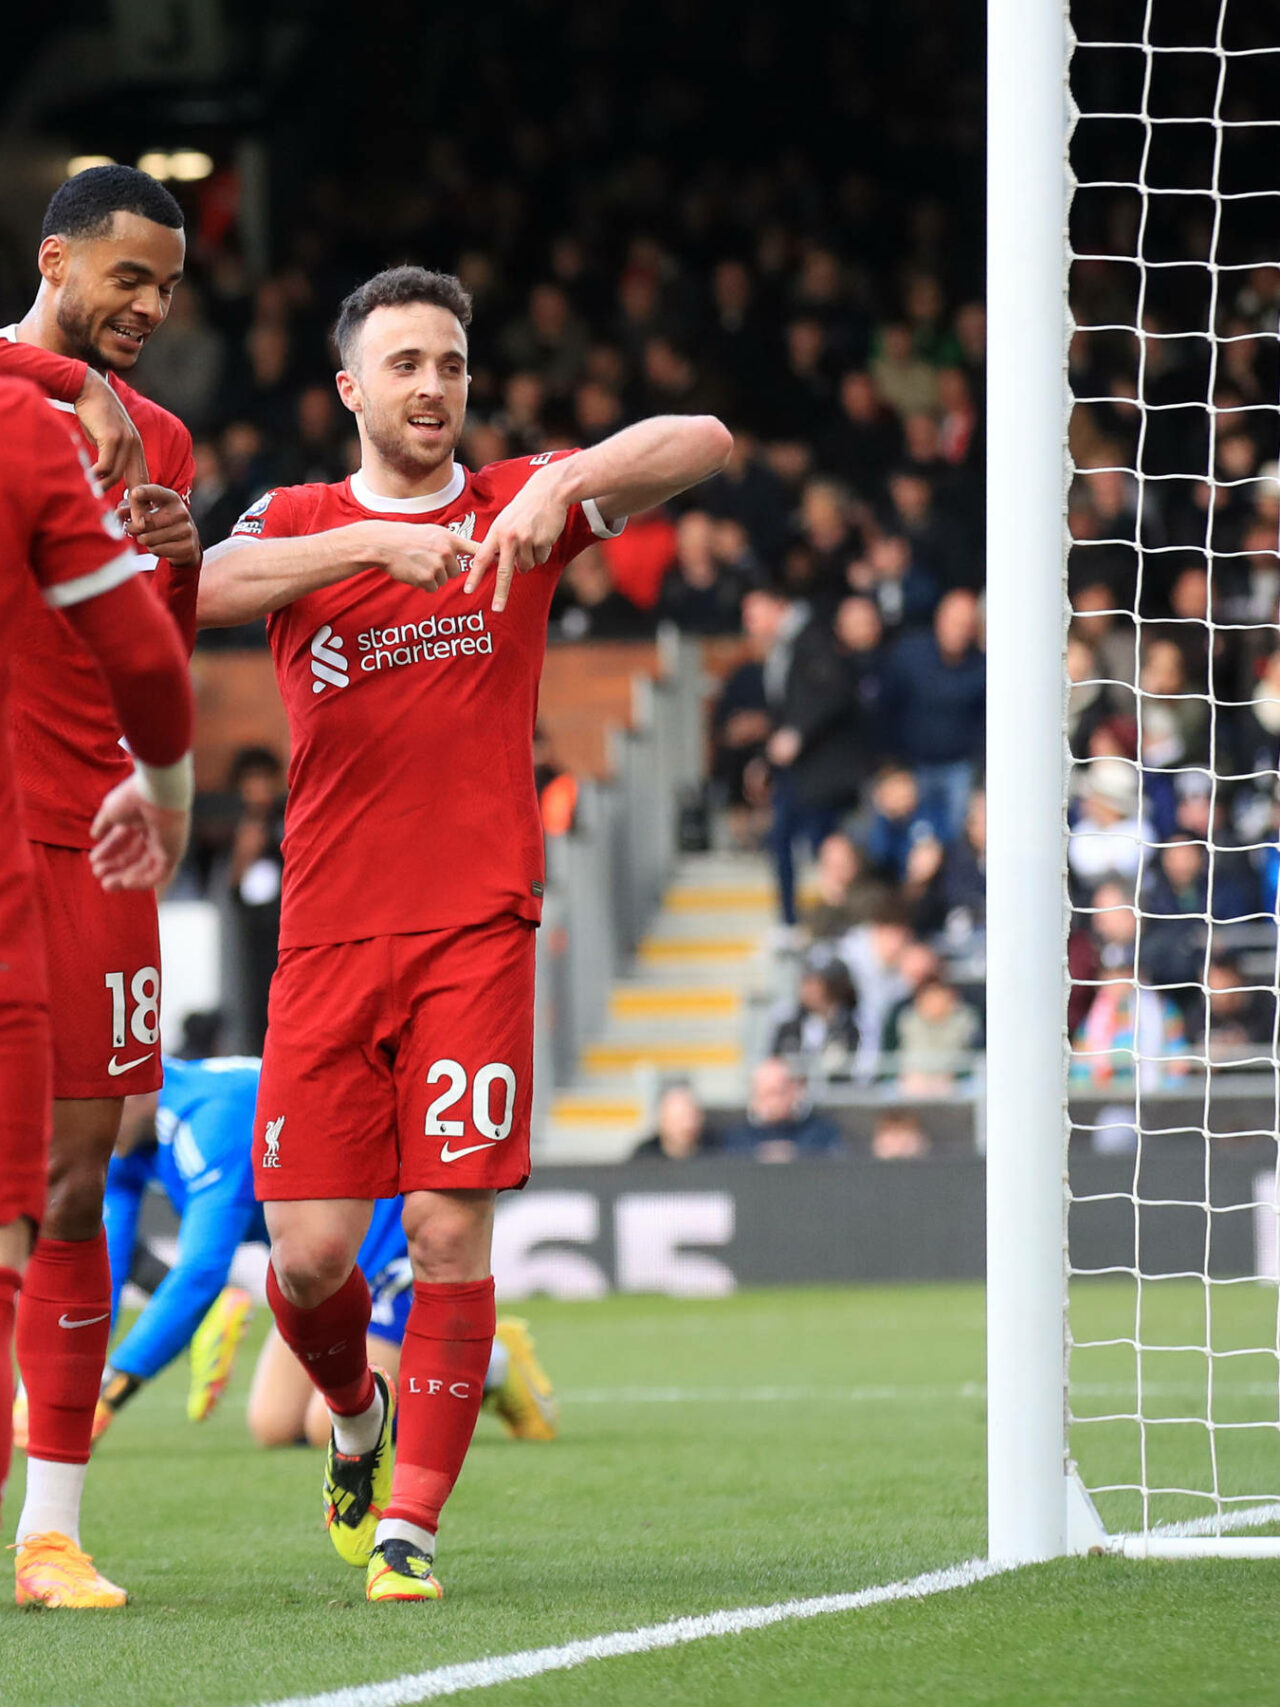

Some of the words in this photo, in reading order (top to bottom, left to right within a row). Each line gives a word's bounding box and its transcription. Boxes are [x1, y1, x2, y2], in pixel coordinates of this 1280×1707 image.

[357, 609, 484, 651] standard
[360, 631, 493, 671] chartered
[105, 966, 160, 1048] 18
[424, 1059, 516, 1140] 20
[409, 1377, 470, 1398] LFC
